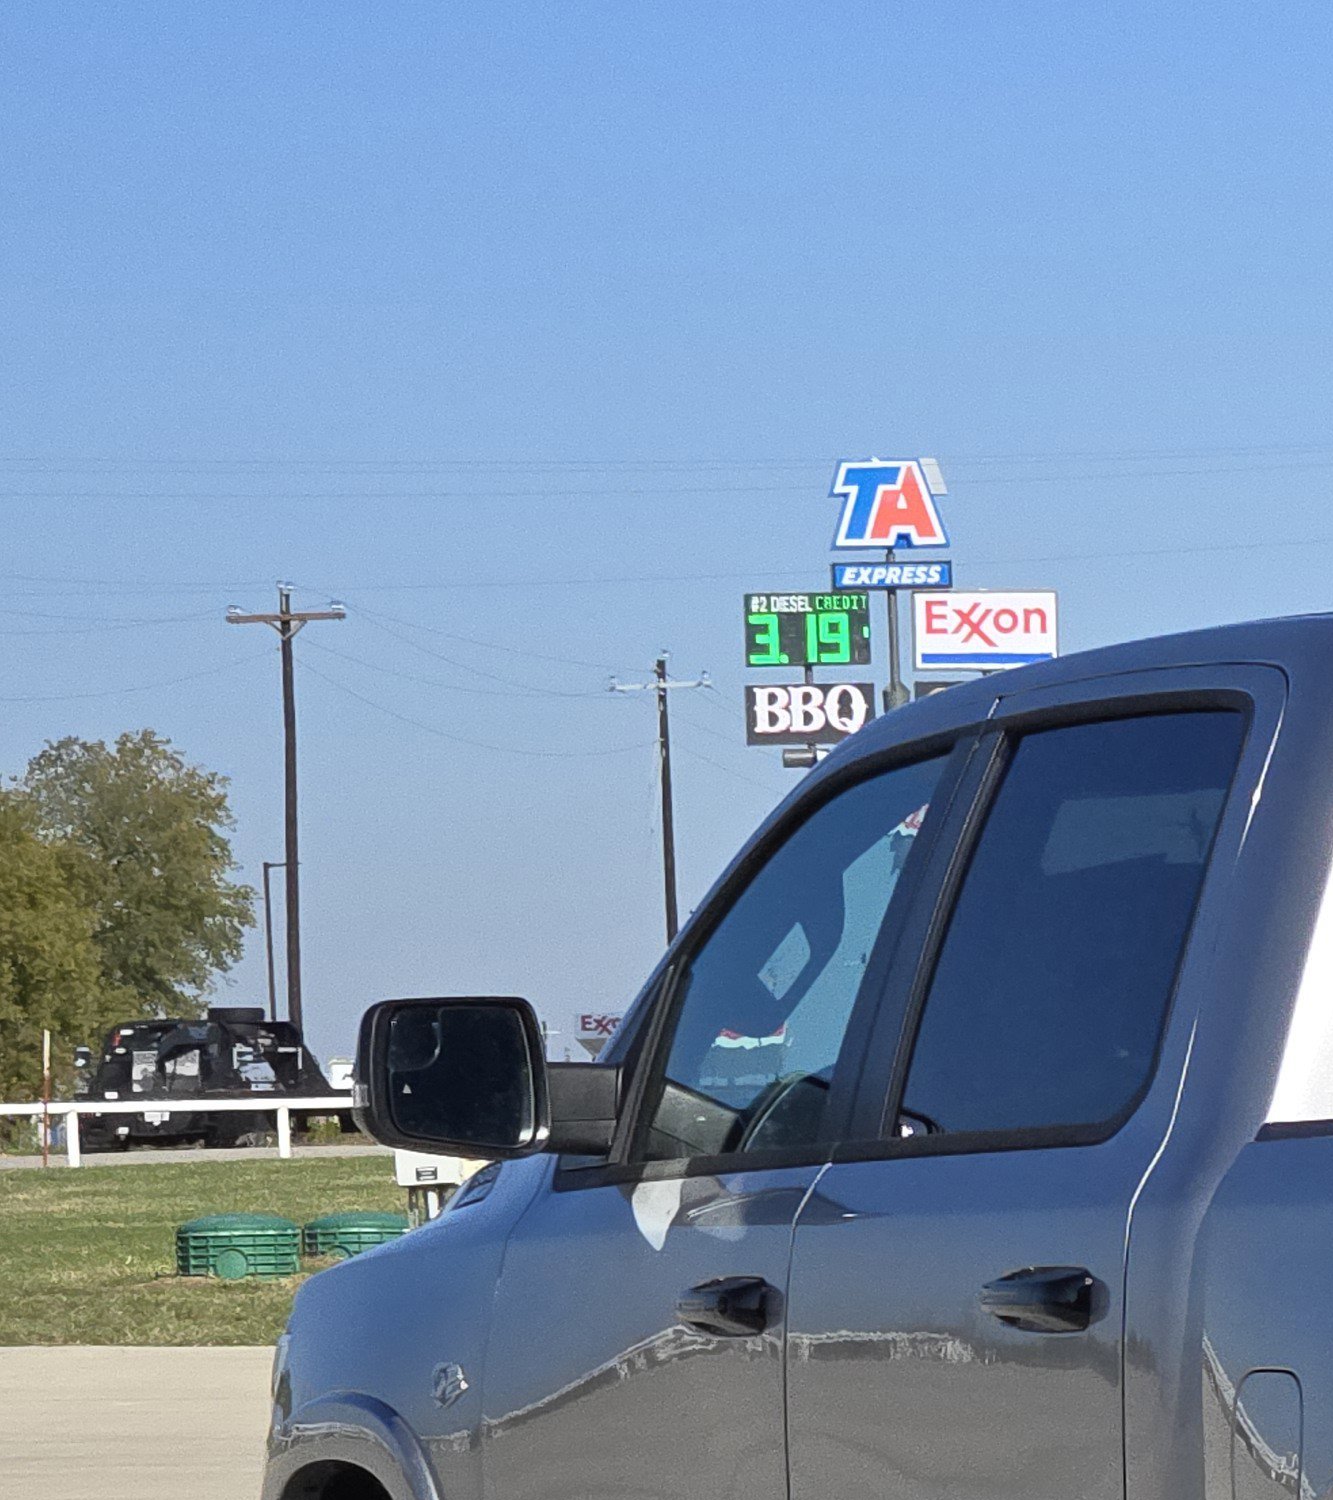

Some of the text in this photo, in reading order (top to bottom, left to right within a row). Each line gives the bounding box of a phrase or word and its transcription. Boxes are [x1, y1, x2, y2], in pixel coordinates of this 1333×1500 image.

[836, 462, 944, 545] TA
[842, 565, 941, 586] EXPRESS
[751, 595, 867, 613] #2 DIESEL CREDIT
[925, 601, 1048, 647] Exxon
[753, 684, 868, 734] BBQ
[581, 1014, 621, 1036] Exx
